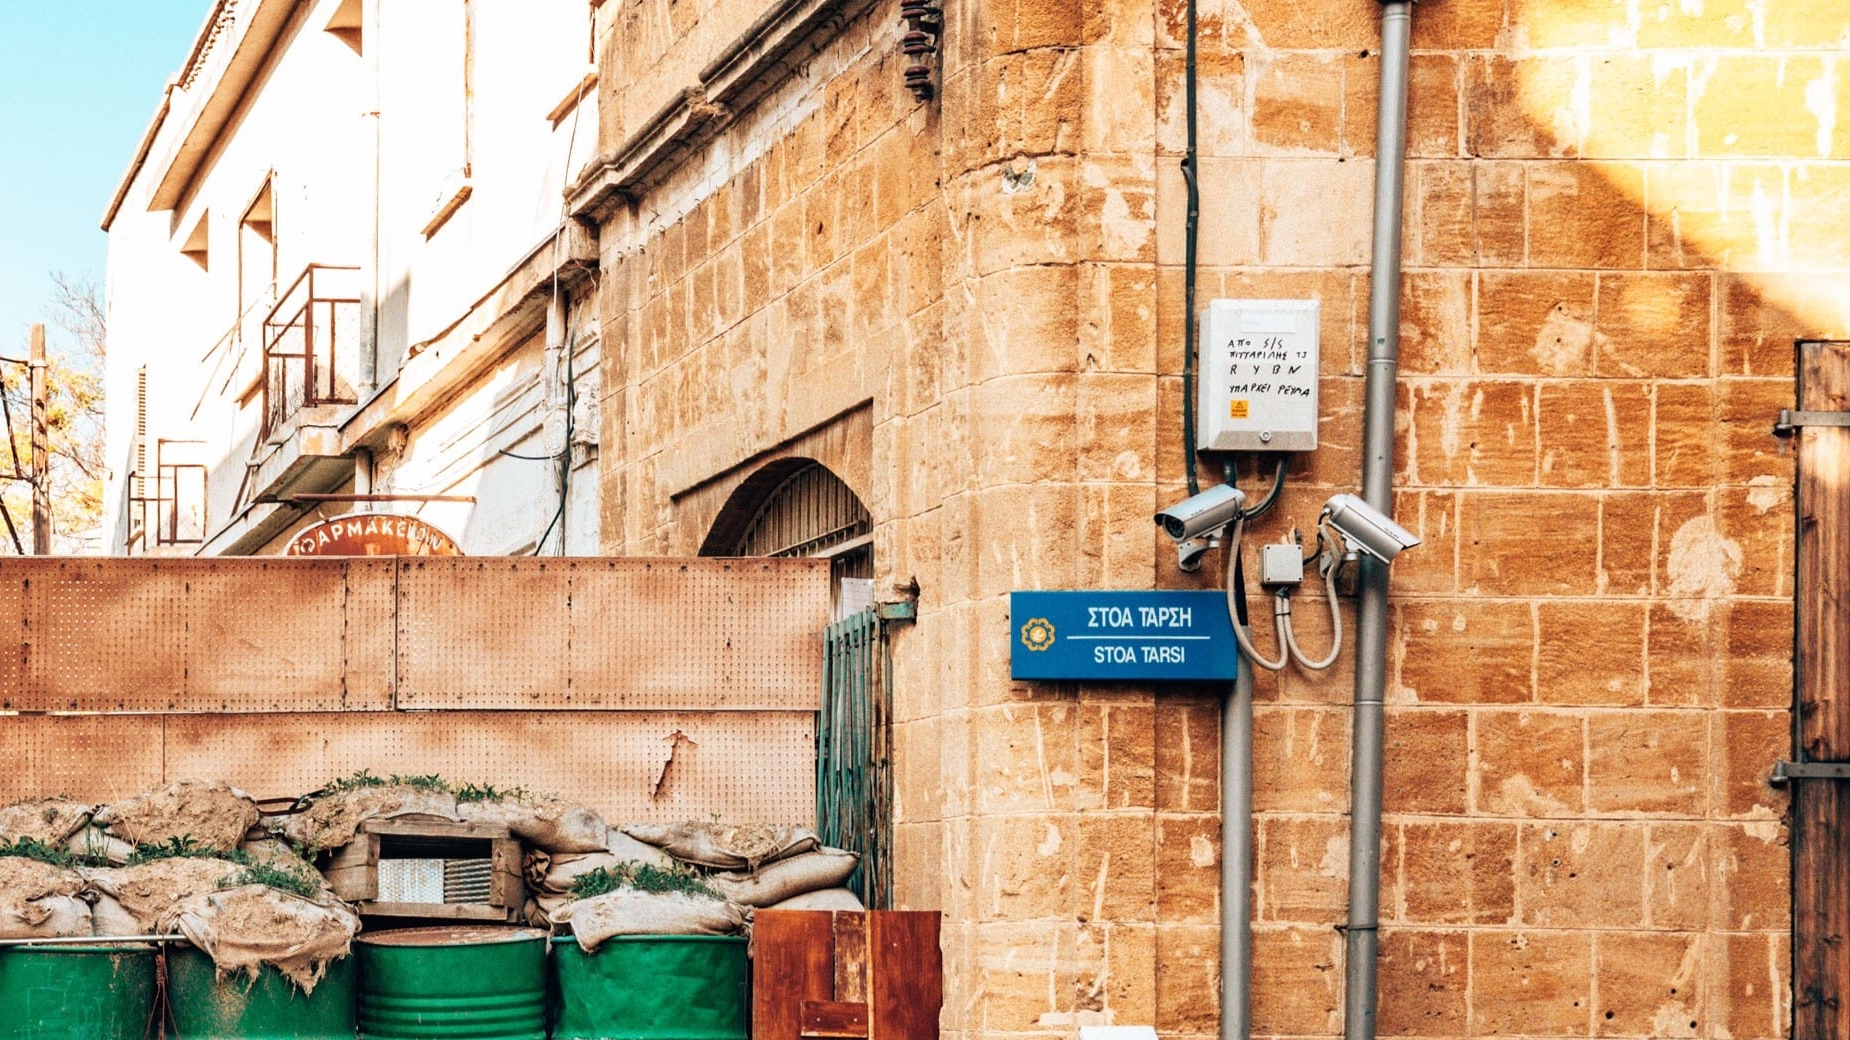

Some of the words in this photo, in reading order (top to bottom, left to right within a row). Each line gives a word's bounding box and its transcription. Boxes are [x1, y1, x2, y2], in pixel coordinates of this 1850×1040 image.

[1087, 606, 1134, 628] ΣΤΟΑ
[1138, 606, 1192, 628] ΤΑΡΣΗ
[1093, 646, 1137, 664] STOA
[1141, 646, 1185, 663] TARSI
